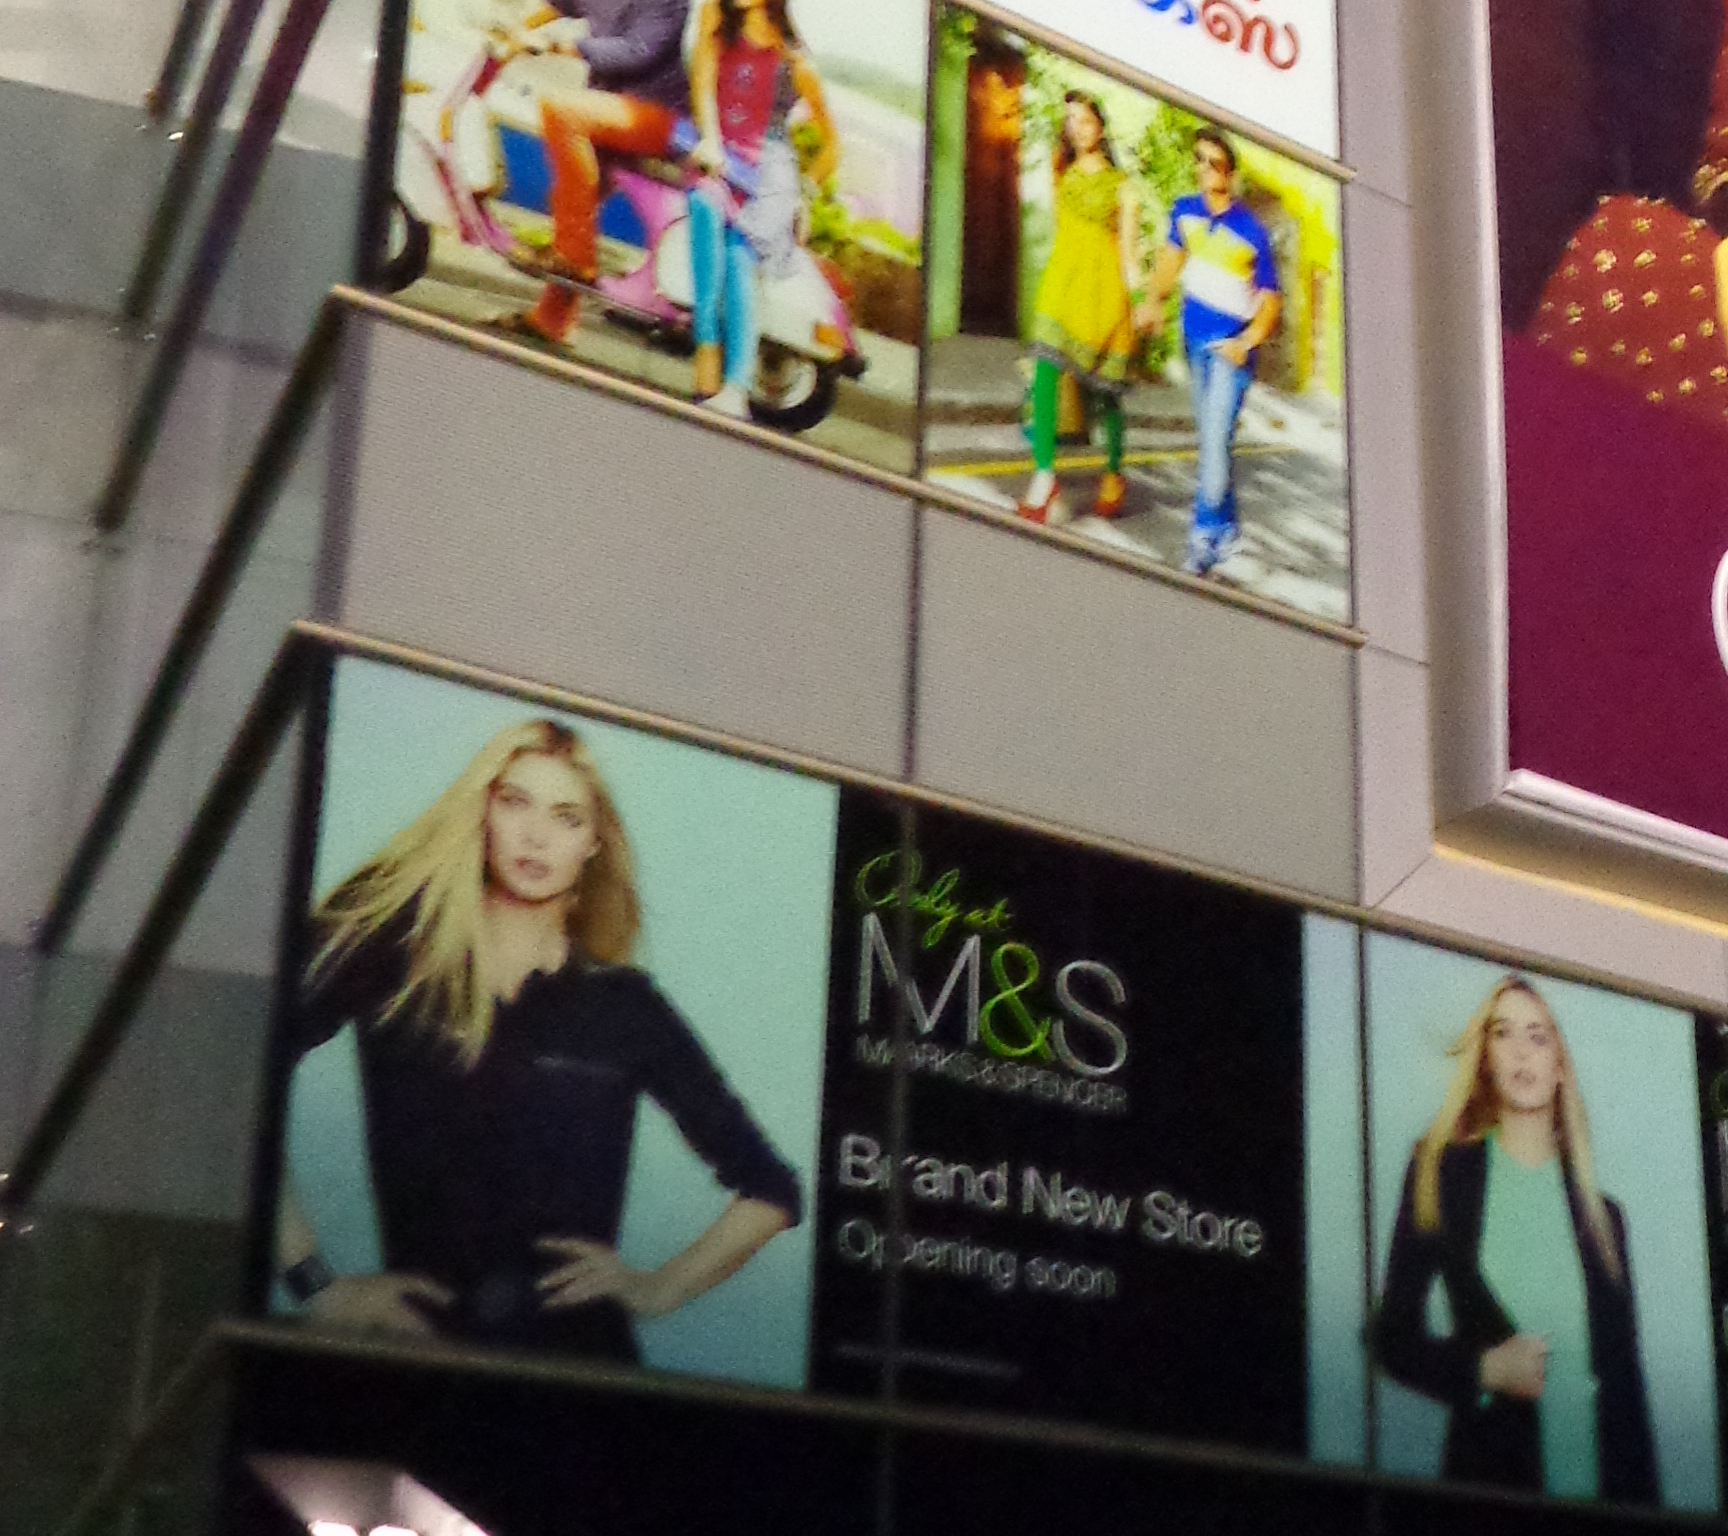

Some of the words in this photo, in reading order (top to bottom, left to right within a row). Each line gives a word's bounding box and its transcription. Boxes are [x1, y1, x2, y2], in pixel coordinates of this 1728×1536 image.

[856, 910, 1128, 1077] M&S
[838, 1132, 1009, 1210] Brand
[1021, 1165, 1133, 1231] New
[1141, 1189, 1264, 1259] Store
[1024, 1254, 1118, 1300] soon
